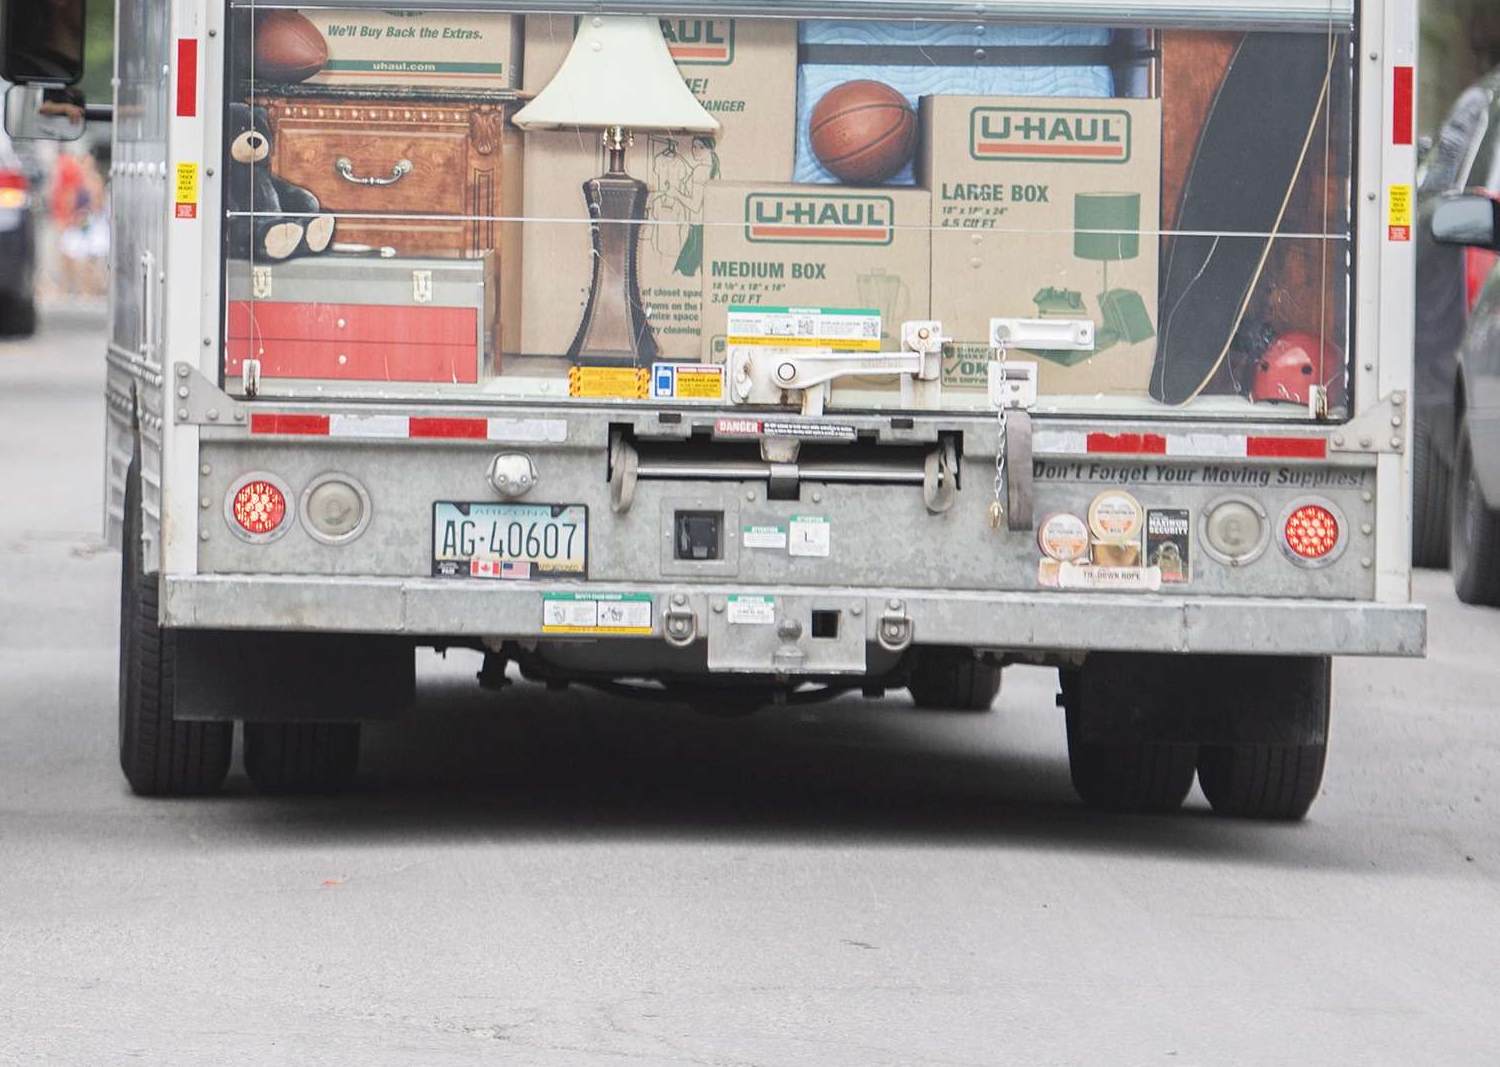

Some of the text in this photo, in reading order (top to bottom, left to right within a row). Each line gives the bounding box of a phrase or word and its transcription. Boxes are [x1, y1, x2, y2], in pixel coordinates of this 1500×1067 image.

[328, 24, 483, 40] We'll Buy Back the Extras.
[373, 62, 436, 71] uhaul.com
[982, 116, 1120, 142] U-HAUL
[941, 183, 1049, 203] LARGE BOX
[755, 201, 884, 225] U-HAUL
[941, 218, 962, 228] 4.5
[982, 219, 996, 228] FT
[711, 260, 827, 280] MEDIUM BOX
[642, 287, 702, 299] of closet spac
[711, 294, 762, 304] 3.0 CU FT
[684, 302, 697, 311] the
[673, 313, 699, 322] space
[663, 325, 701, 336] cleaning
[960, 361, 989, 376] OK
[719, 419, 759, 433] DANGER
[1032, 461, 1367, 488] Don't Forget Your Moving Supplies!
[474, 507, 550, 518] ARIZONA
[1148, 518, 1188, 528] MAXIMUM
[1148, 527, 1188, 535] SECURITY
[1121, 572, 1141, 580] ROPE
